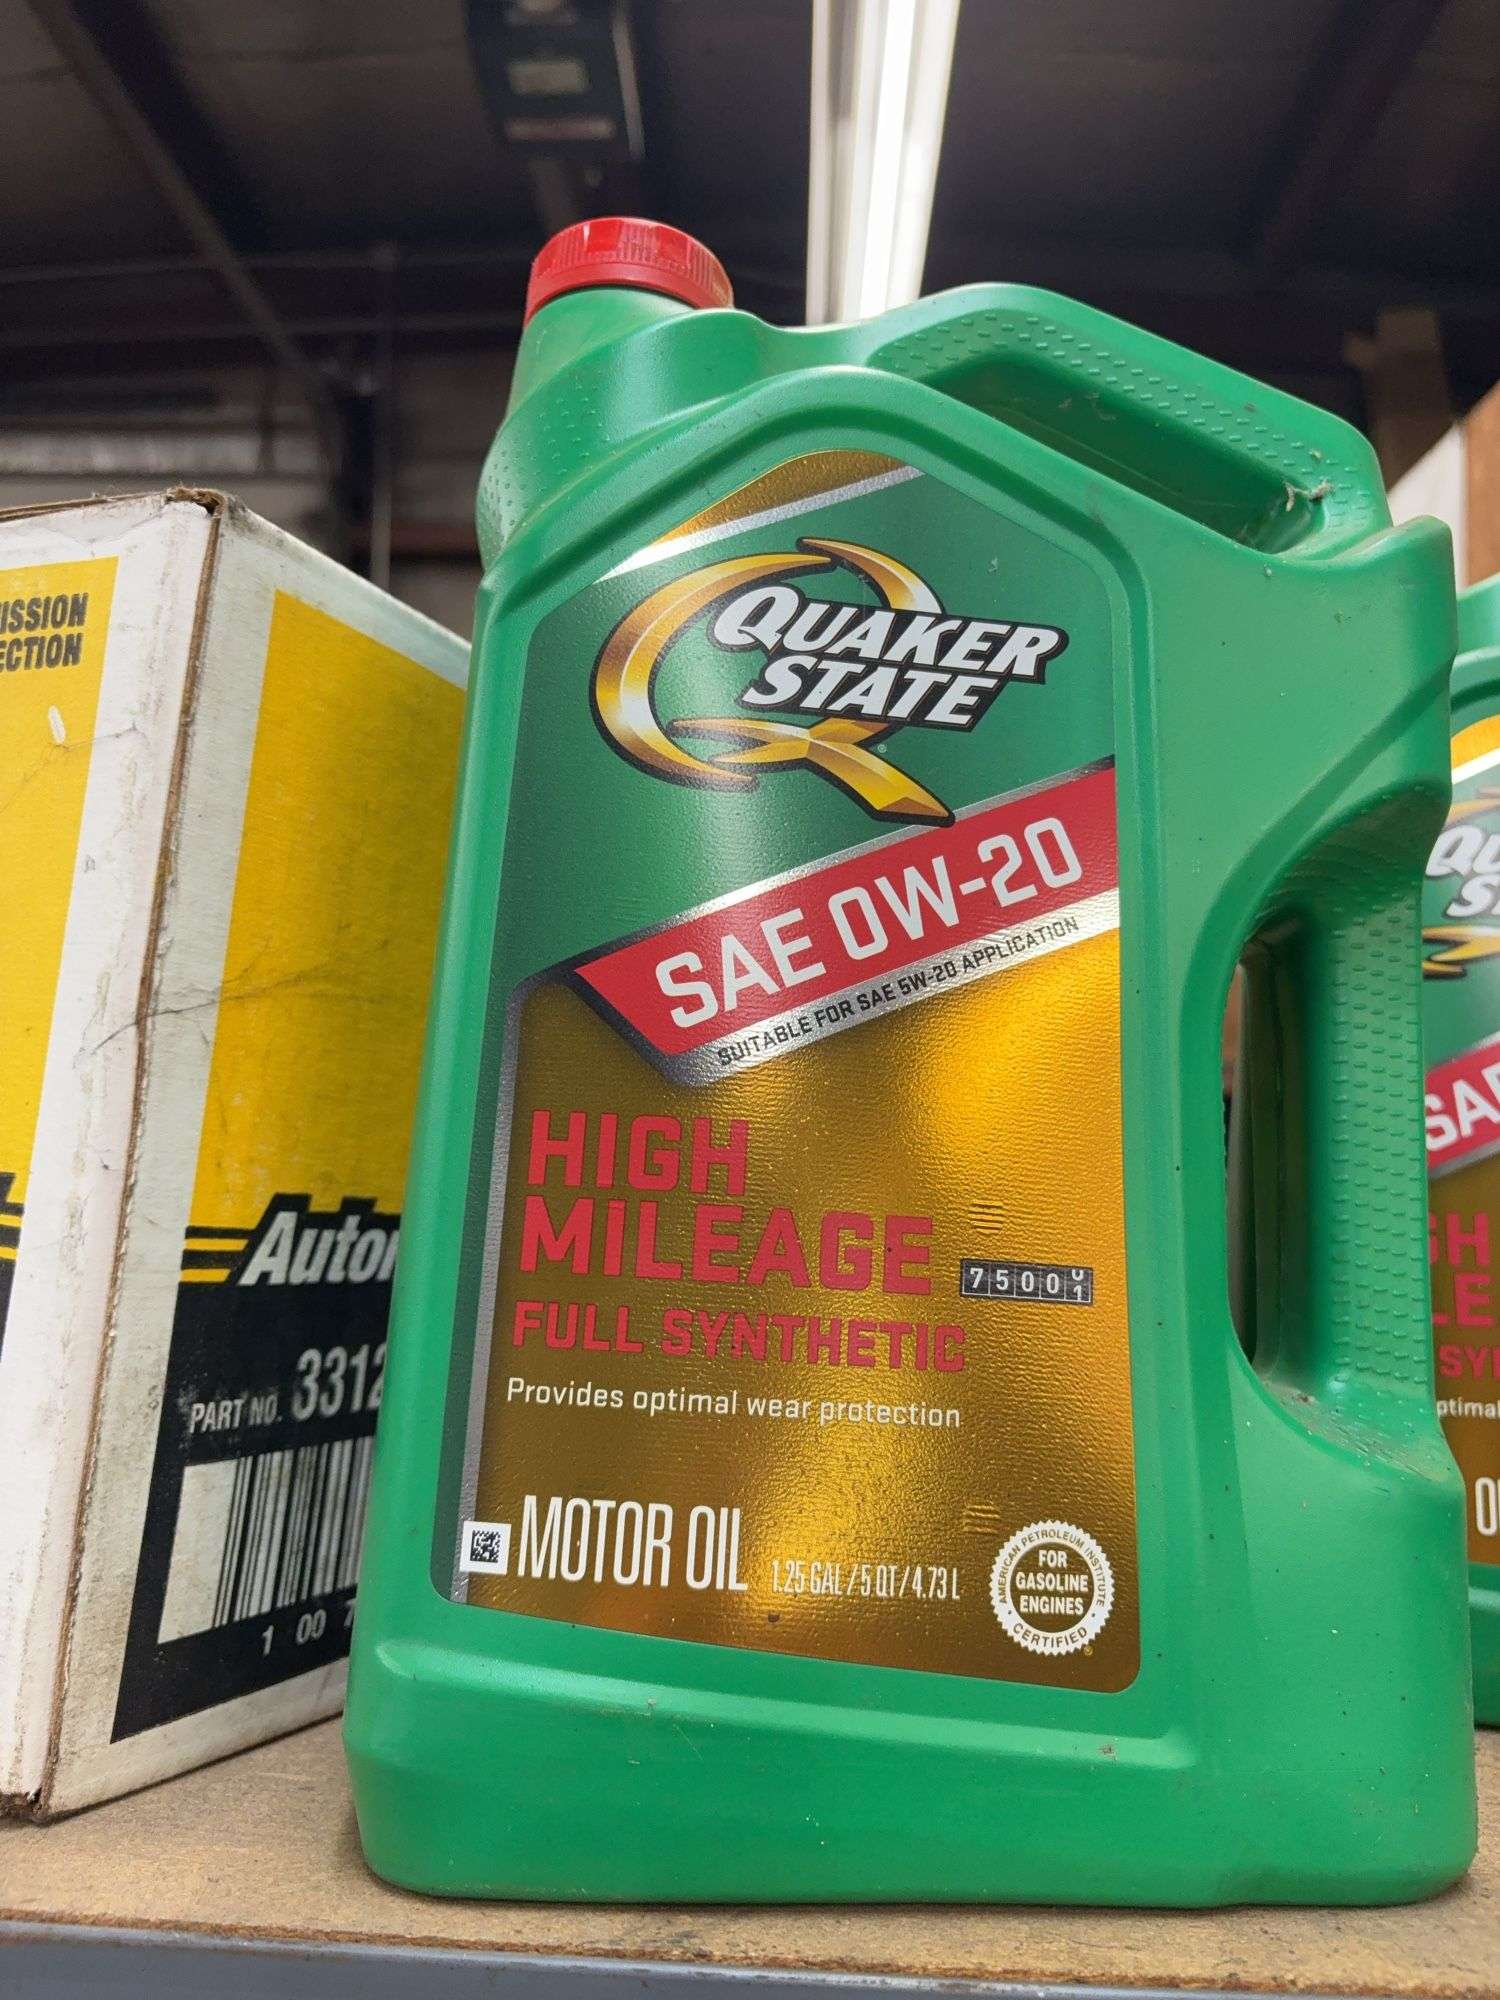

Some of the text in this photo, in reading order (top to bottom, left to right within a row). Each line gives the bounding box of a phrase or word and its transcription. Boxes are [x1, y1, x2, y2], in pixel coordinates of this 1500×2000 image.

[713, 586, 1059, 677] QUAKER
[743, 656, 994, 725] STATE
[655, 817, 1083, 1028] SAE 0W-20
[717, 916, 1080, 1067] SUITABLE FOR SAE 5W-20 APPLICATION
[527, 1110, 750, 1196] HIGH
[518, 1195, 934, 1296] MILEAGE
[512, 1300, 967, 1374] FULL SYNTHETIC
[189, 1398, 245, 1434] PART
[249, 1393, 283, 1426] NO.
[507, 1377, 962, 1429] Provides optimal wear protection
[517, 1495, 747, 1592] MOTOR OIL
[998, 1528, 1106, 1607] AMERICAN PETROLEUM INSTITUTE
[1038, 1549, 1068, 1568] FOR
[771, 1558, 805, 1594] 1.25
[810, 1561, 843, 1596] GAL
[875, 1565, 898, 1597] QT
[912, 1566, 948, 1599] 4.73
[1015, 1571, 1089, 1593] GASOLINE
[1019, 1595, 1084, 1616] ENGINES
[262, 1625, 274, 1657] 1
[1012, 1622, 1088, 1648] CERTIFIED
